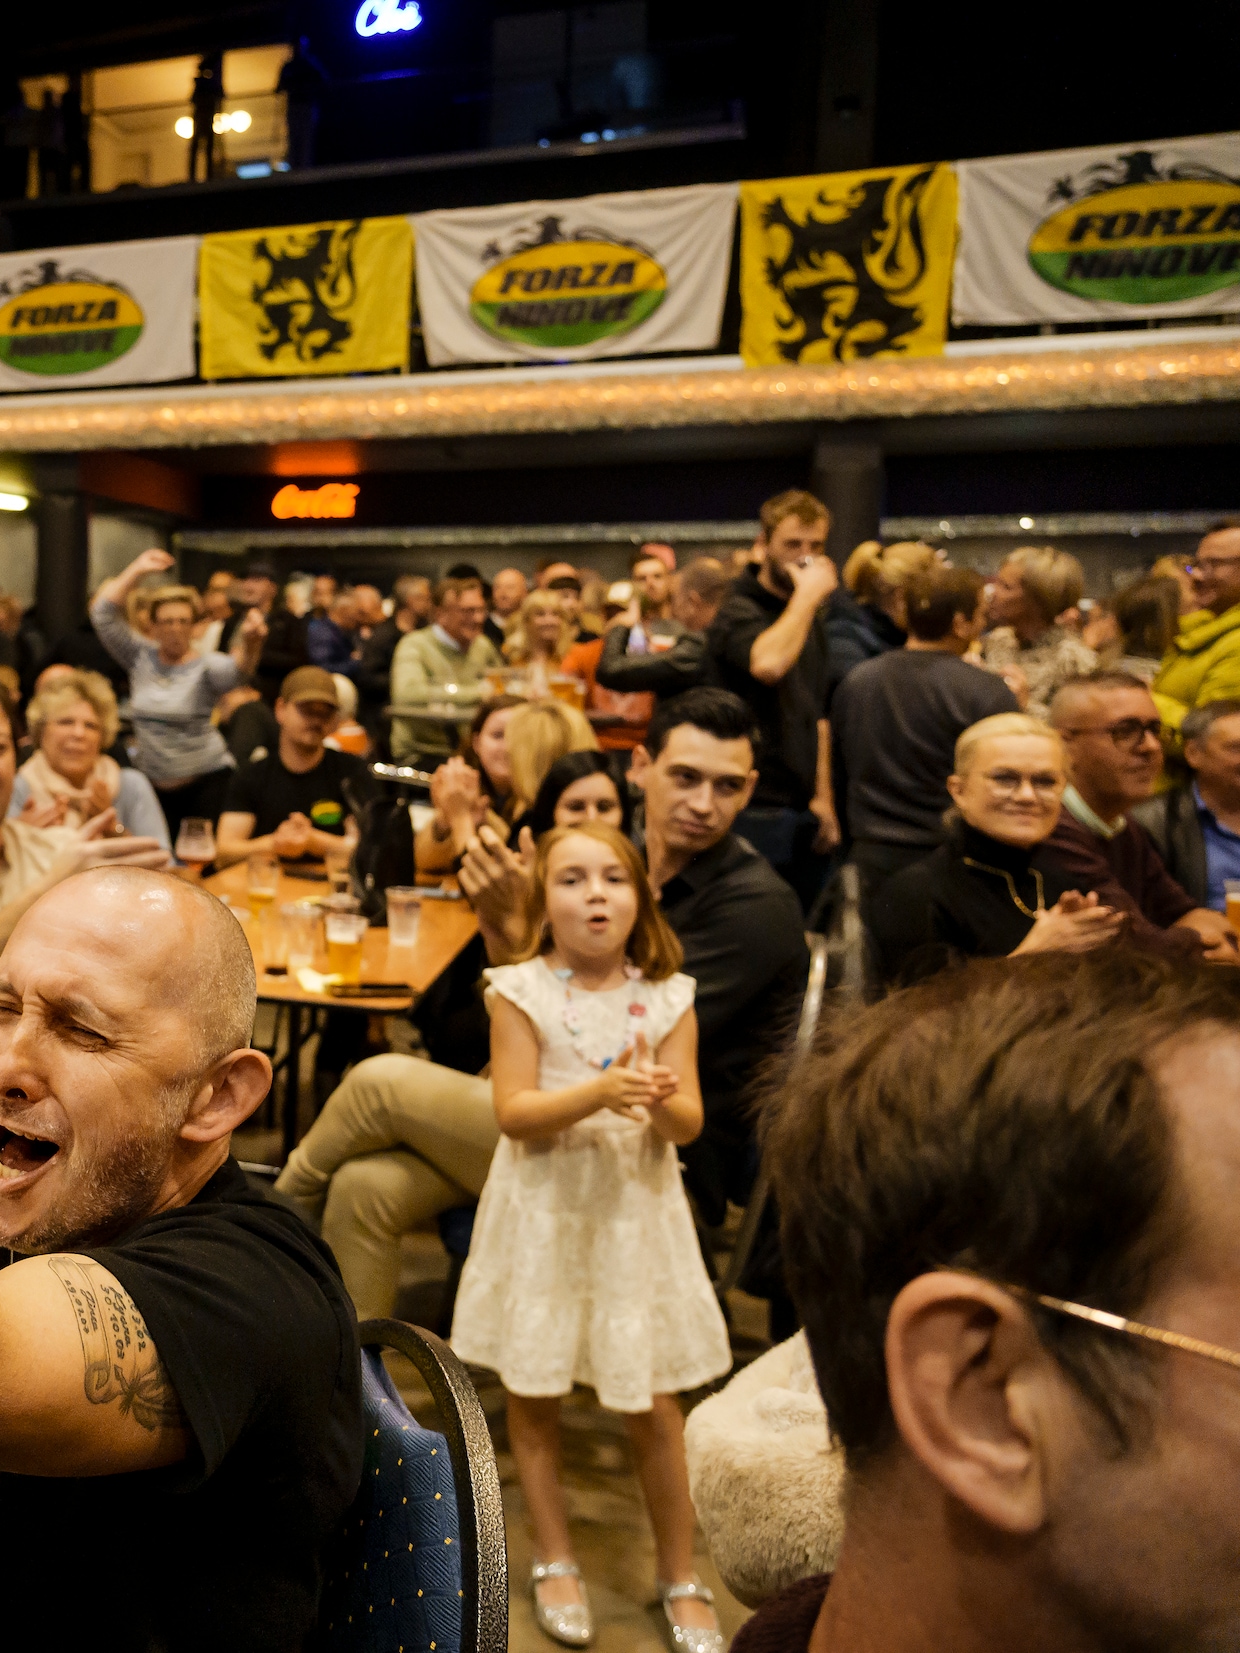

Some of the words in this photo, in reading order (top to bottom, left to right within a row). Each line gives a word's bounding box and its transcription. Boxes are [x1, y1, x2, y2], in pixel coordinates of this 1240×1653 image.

[1068, 203, 1240, 242] FORZA
[498, 261, 636, 294] FORZA
[10, 300, 117, 328] FORZA
